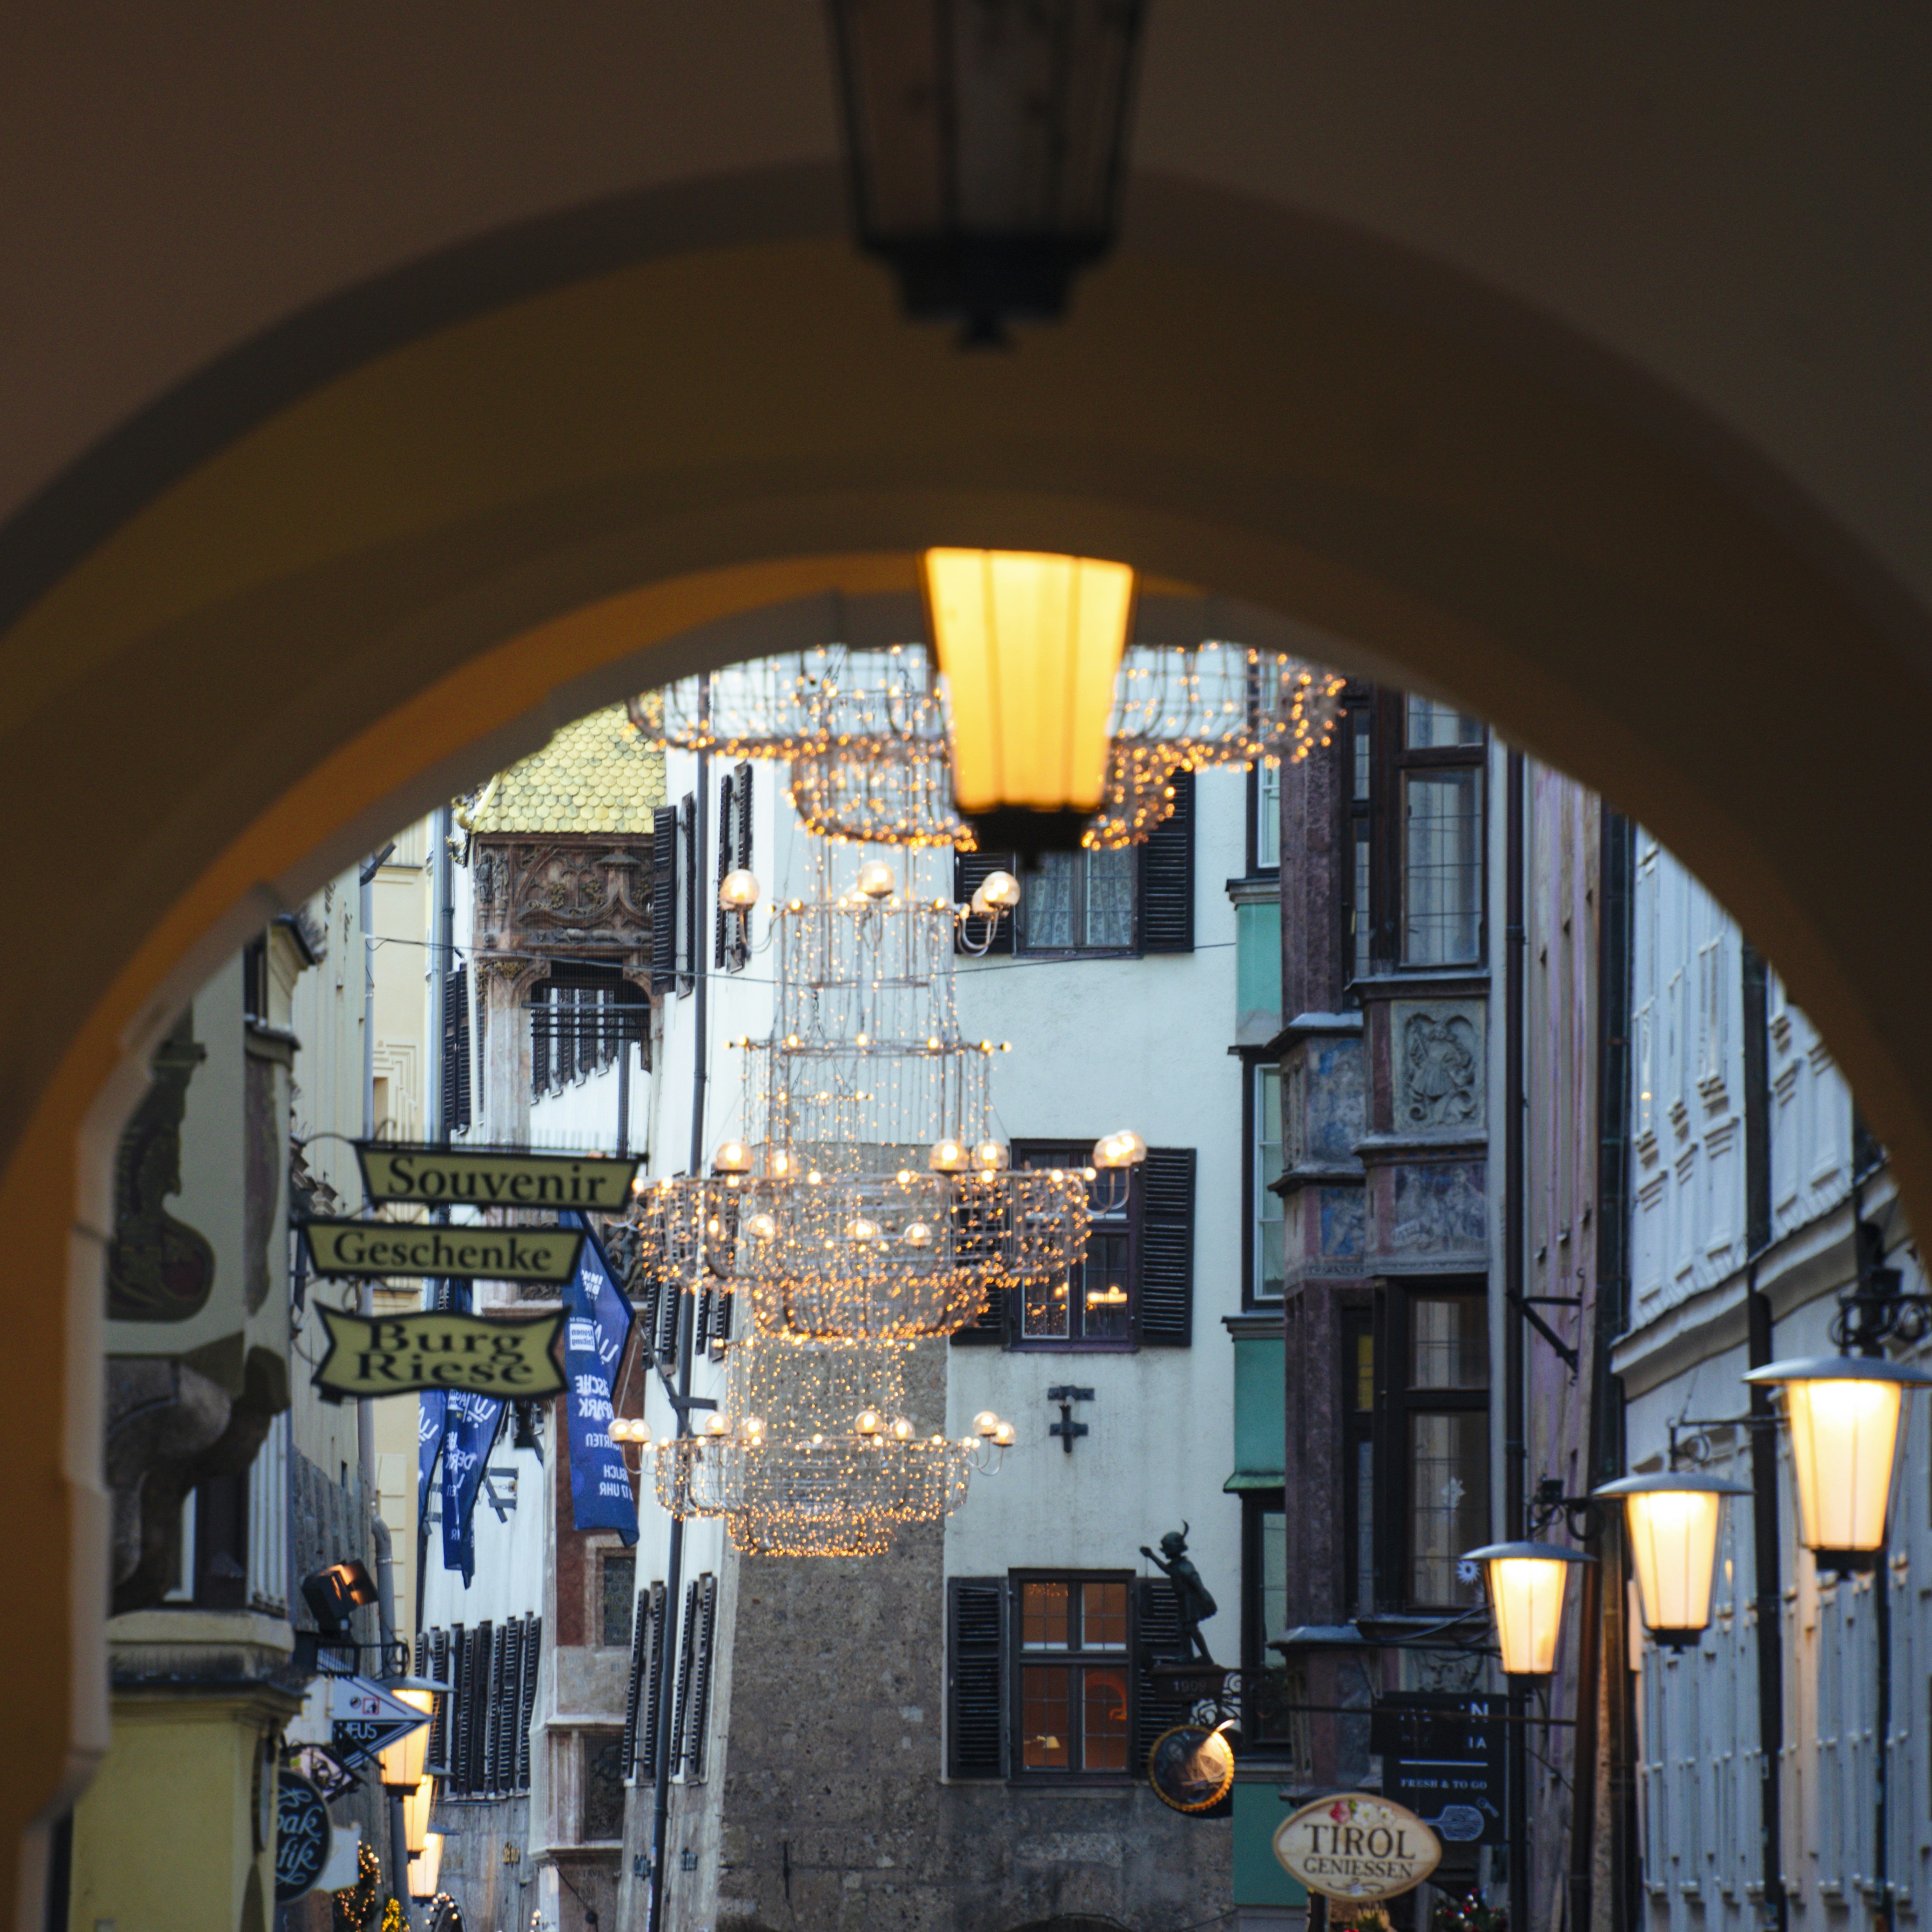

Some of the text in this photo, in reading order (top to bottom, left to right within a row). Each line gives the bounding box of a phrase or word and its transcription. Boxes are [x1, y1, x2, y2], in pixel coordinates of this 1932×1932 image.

[387, 1156, 606, 1202] Souvenir
[333, 1231, 551, 1272] Geschenke
[370, 1323, 524, 1365] Burg
[356, 1354, 534, 1384] Riese
[1174, 1679, 1207, 1692] 1909
[1400, 1778, 1438, 1788] FRESH
[1452, 1779, 1468, 1789] TO
[1470, 1780, 1487, 1789] GO
[1303, 1823, 1416, 1860] TIROL
[1303, 1856, 1413, 1880] GENIESSEN
